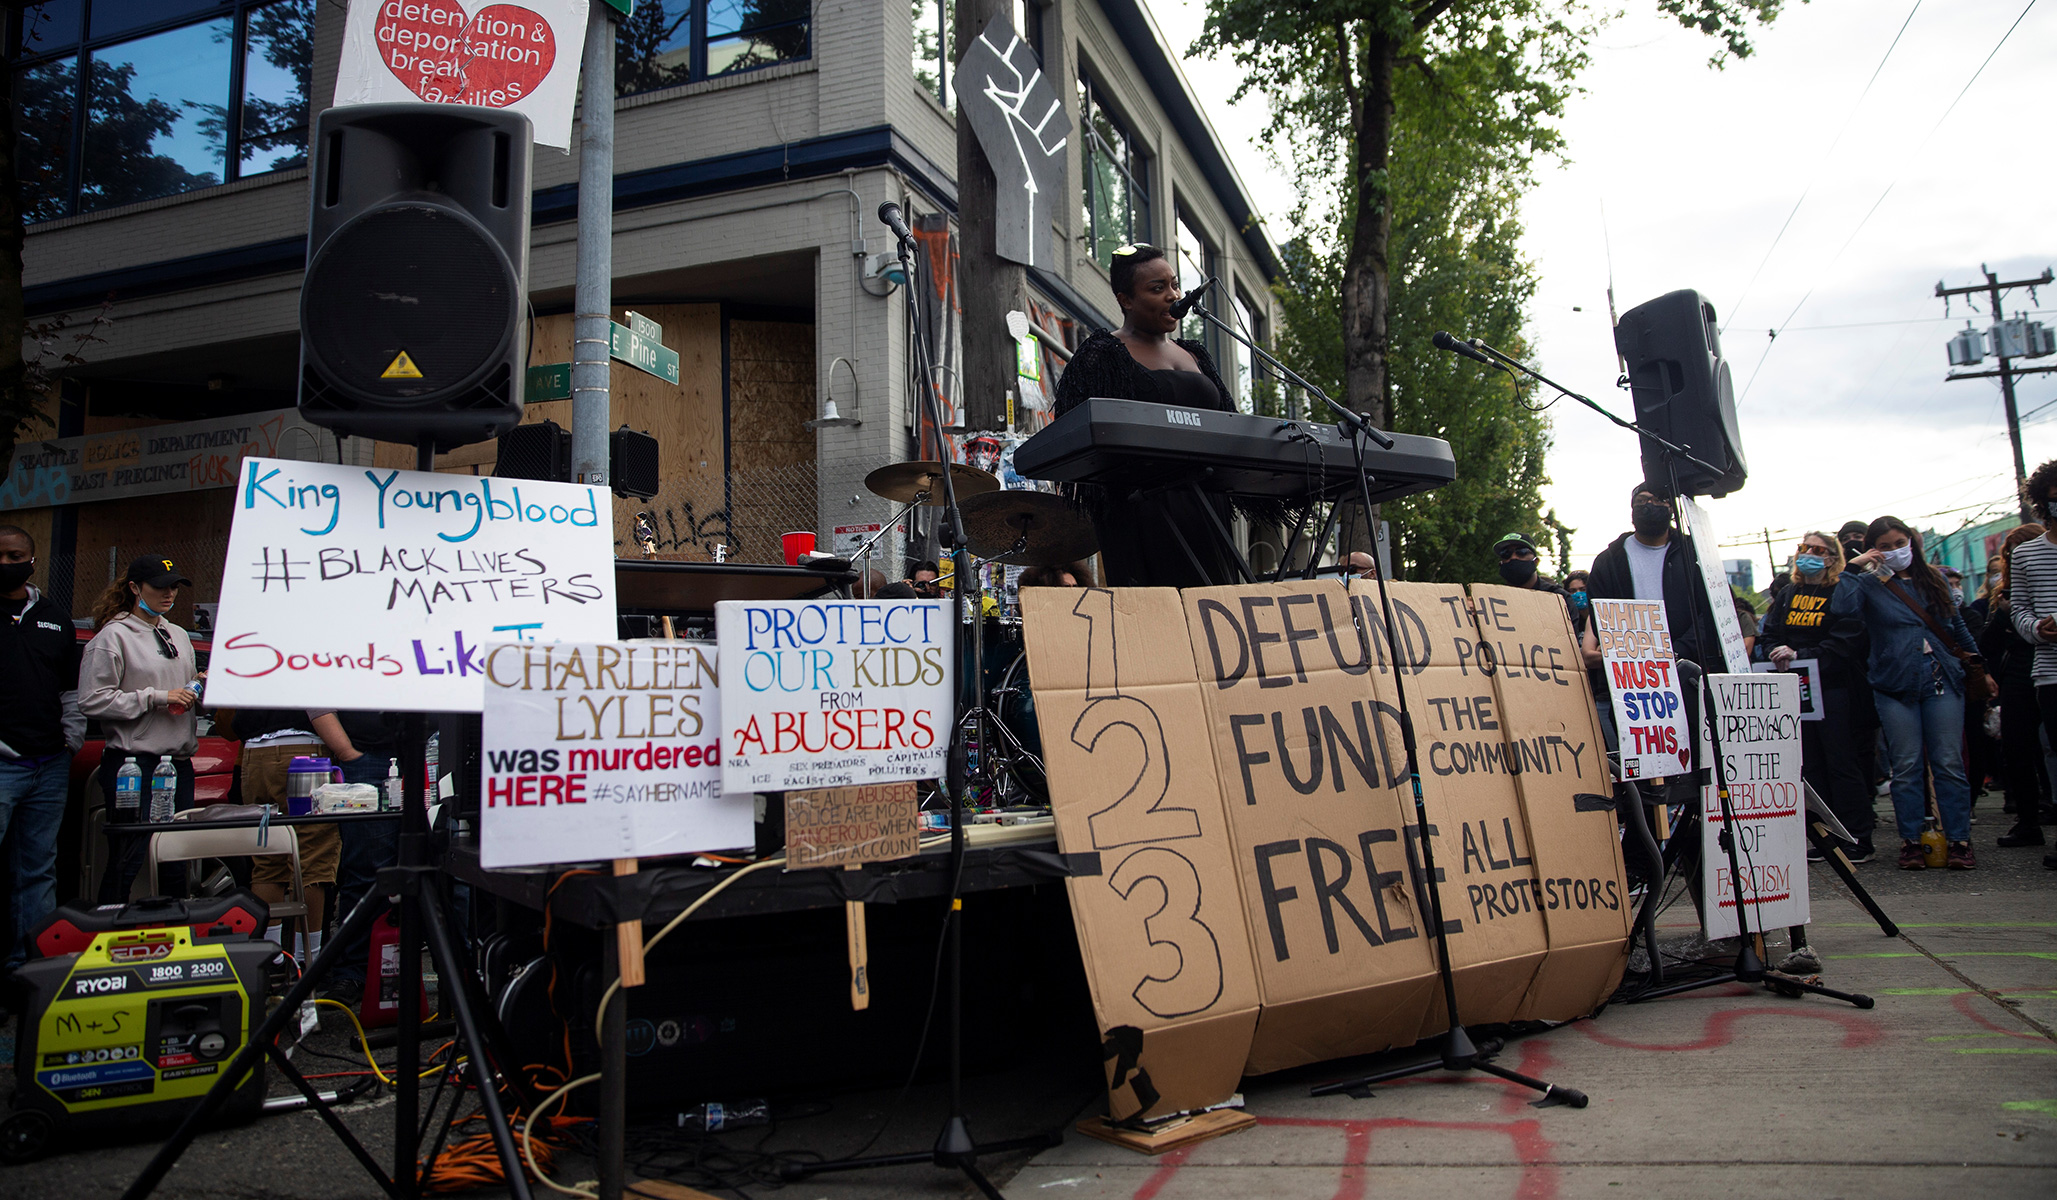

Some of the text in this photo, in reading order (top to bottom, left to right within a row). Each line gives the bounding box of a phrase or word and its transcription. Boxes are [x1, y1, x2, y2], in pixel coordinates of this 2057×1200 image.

[378, 23, 540, 65] deportation
[530, 23, 545, 43] &
[391, 48, 467, 79] break
[638, 319, 656, 339] 1500
[612, 334, 676, 378] E Pine ST
[535, 374, 561, 390] AVE
[1166, 409, 1201, 427] KORG
[18, 427, 251, 470] SEATTLE POLICE DEPARTMENT
[71, 462, 189, 492] EAST PRECINCT
[189, 453, 238, 488] FUCK
[245, 462, 340, 535] King
[365, 470, 598, 542] Youngblood
[251, 545, 546, 592] #BLACK LIVES
[387, 574, 602, 614] MATTERS
[744, 604, 940, 650] PROTECT
[1595, 602, 1664, 631] WHITE
[1785, 611, 1826, 627] SILENT
[224, 632, 403, 677] Sounds
[1198, 593, 1516, 690] DEFUND THE
[1599, 630, 1673, 659] PEOPLE
[487, 644, 719, 691] CHARLEEN
[745, 647, 944, 692] OUR KIDS
[1454, 637, 1569, 686] POLICE
[1611, 660, 1670, 689] MUST
[821, 691, 863, 709] FROM
[1623, 690, 1678, 721] STOP
[1719, 683, 1780, 711] WHITE
[555, 694, 703, 740] LYLES
[734, 708, 935, 756] ABUSERS
[488, 738, 721, 773] was murdered
[1230, 696, 1498, 806] FUND THE
[1629, 726, 1678, 755] THIS
[728, 759, 750, 768] NRA
[789, 758, 866, 772] SEX PREDATORS
[869, 766, 927, 776] POLLUTERS
[1071, 695, 1202, 850] 2
[1430, 735, 1585, 779] COMMUNITY
[1744, 753, 1780, 780] THE
[488, 774, 721, 807] HERE #SAYHERNAME
[752, 774, 771, 784] ICE
[784, 776, 824, 786] RACIST
[824, 790, 852, 806] ALL
[856, 783, 918, 804] ABUSERS
[1705, 782, 1797, 813] LIEBLOOD
[788, 800, 915, 828] POLICE ARE MOST
[788, 816, 918, 848] DANGEROUS WHEN
[851, 836, 919, 859] ACCOUNT
[1740, 825, 1766, 852] OF
[1254, 817, 1532, 962] FREE ALL
[1467, 878, 1619, 924] PROTESTORS
[1108, 848, 1224, 1018] 3
[76, 976, 127, 994] RYOBI
[152, 962, 224, 978] 1800 2300
[62, 1070, 97, 1083] Bluetooth
